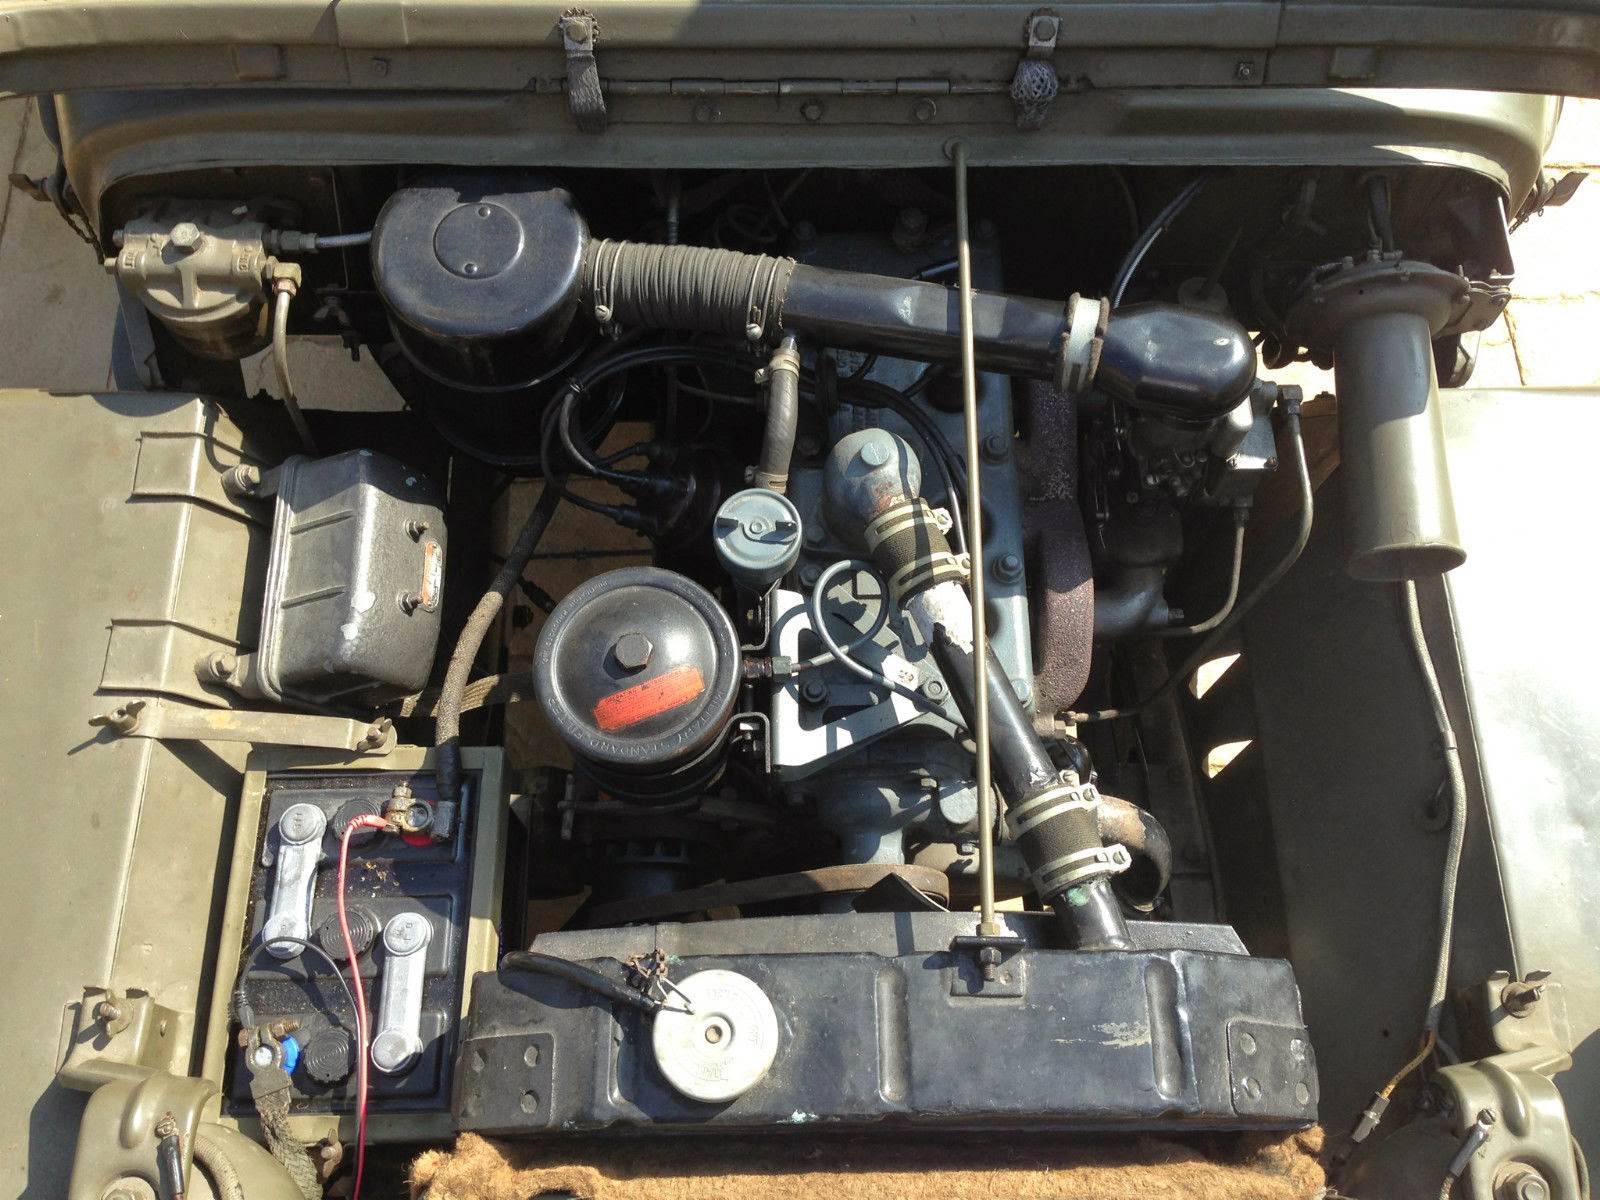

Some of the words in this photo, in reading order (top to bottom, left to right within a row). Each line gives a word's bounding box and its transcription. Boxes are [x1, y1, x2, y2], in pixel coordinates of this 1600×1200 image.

[545, 696, 584, 741] FILTER
[674, 689, 727, 745] MILITARY
[588, 735, 673, 758] STANDARD
